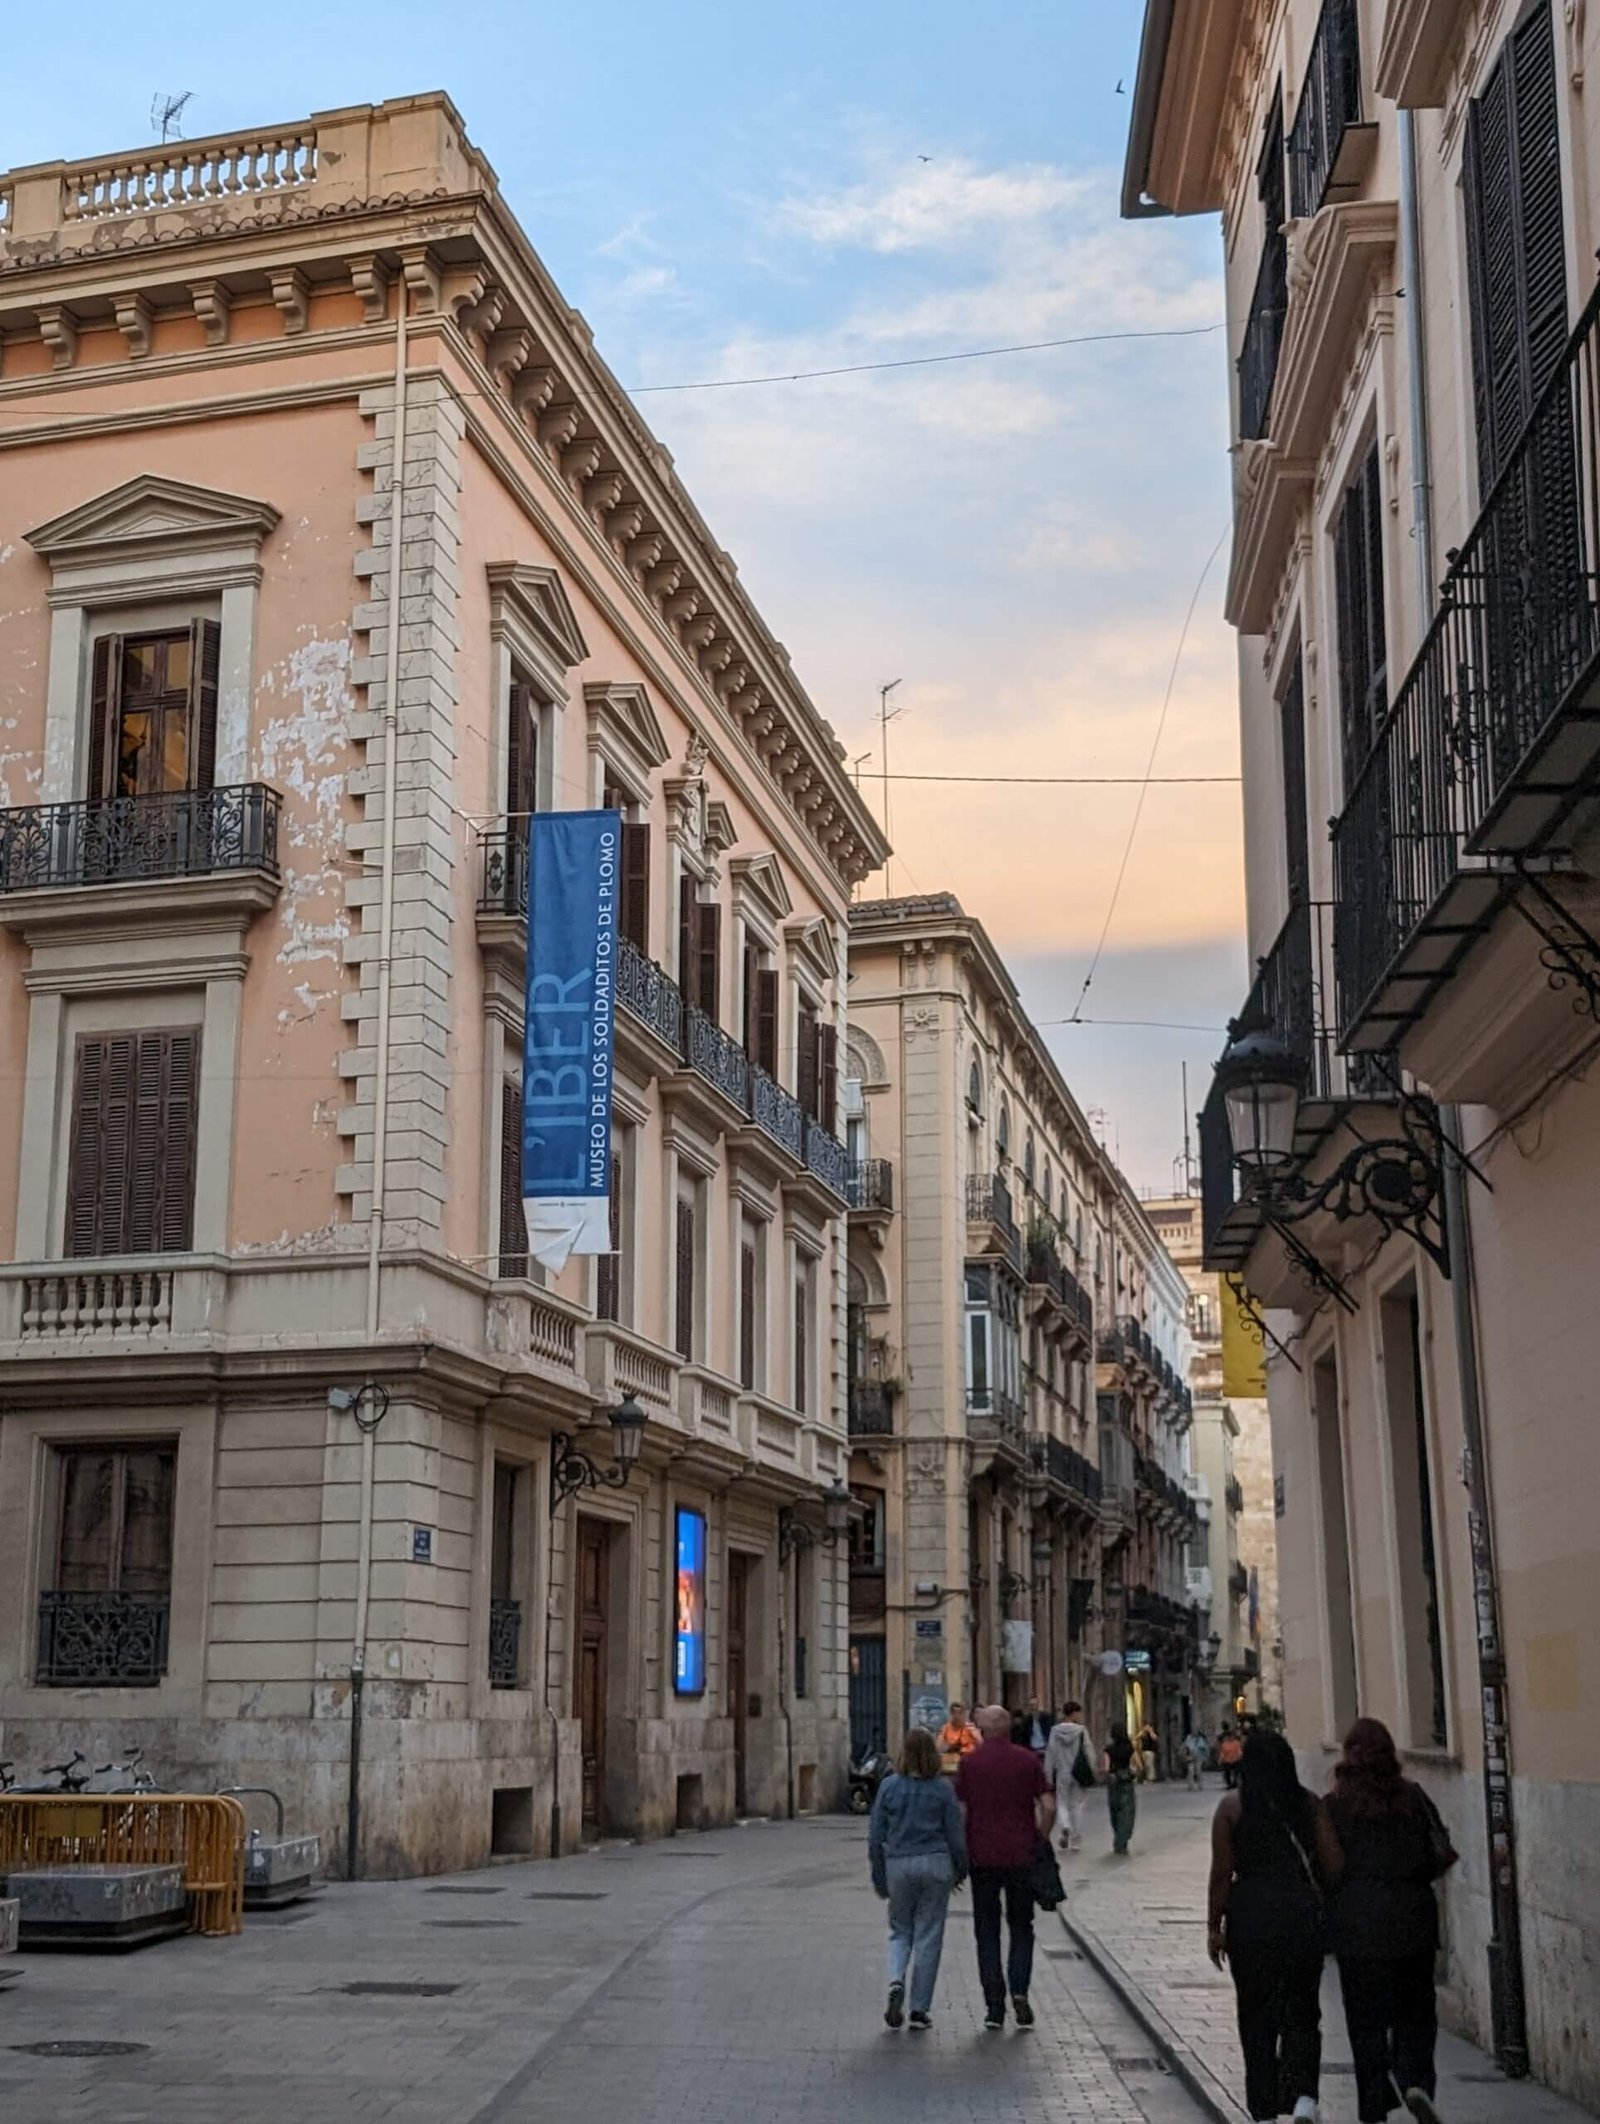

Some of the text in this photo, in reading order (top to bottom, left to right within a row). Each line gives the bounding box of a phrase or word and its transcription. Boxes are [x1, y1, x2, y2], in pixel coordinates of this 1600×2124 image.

[524, 967, 593, 1190] L'IBER
[590, 832, 615, 1188] MUSEO DE LOS SOLDADITOS DE PLOMO
